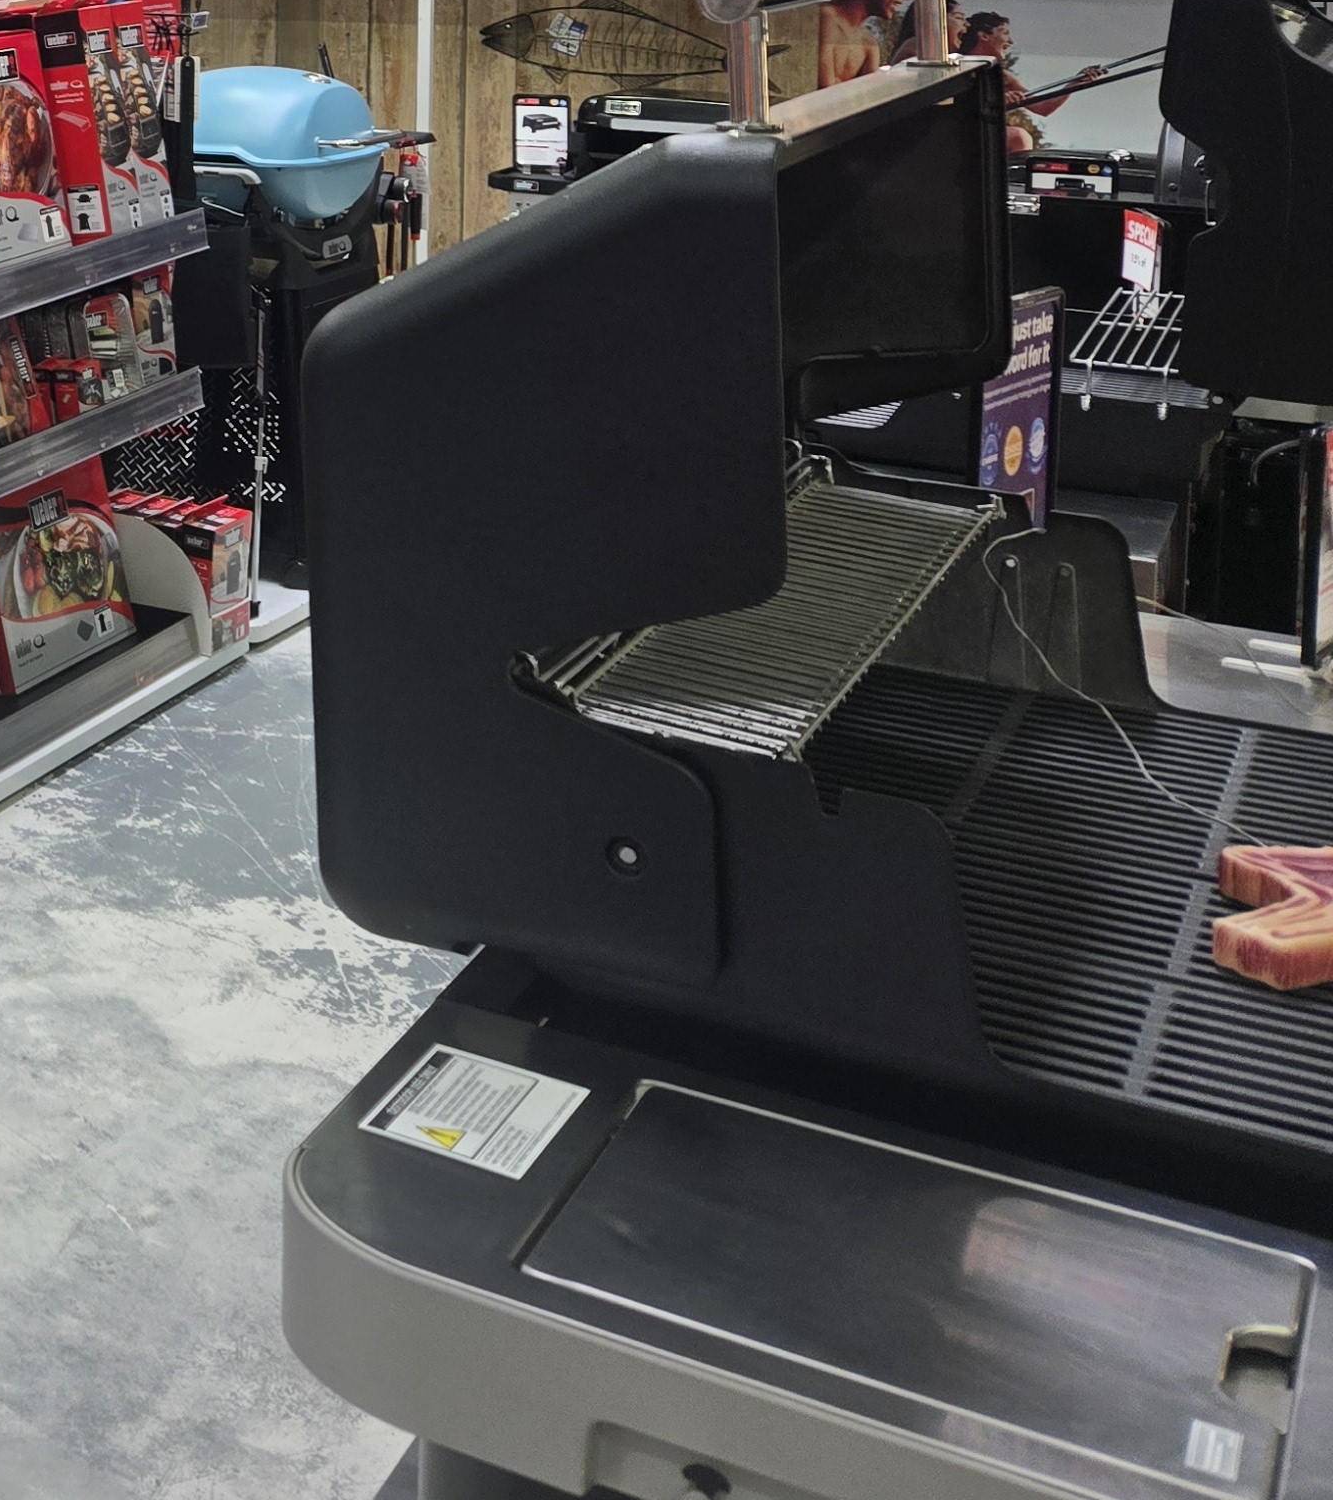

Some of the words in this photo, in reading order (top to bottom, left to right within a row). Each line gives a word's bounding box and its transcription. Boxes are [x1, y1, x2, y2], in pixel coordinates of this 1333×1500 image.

[47, 34, 69, 47] weber
[1031, 311, 1054, 335] take
[10, 340, 31, 384] weber
[1027, 345, 1041, 369] for
[1041, 343, 1050, 364] it
[31, 495, 59, 528] weber
